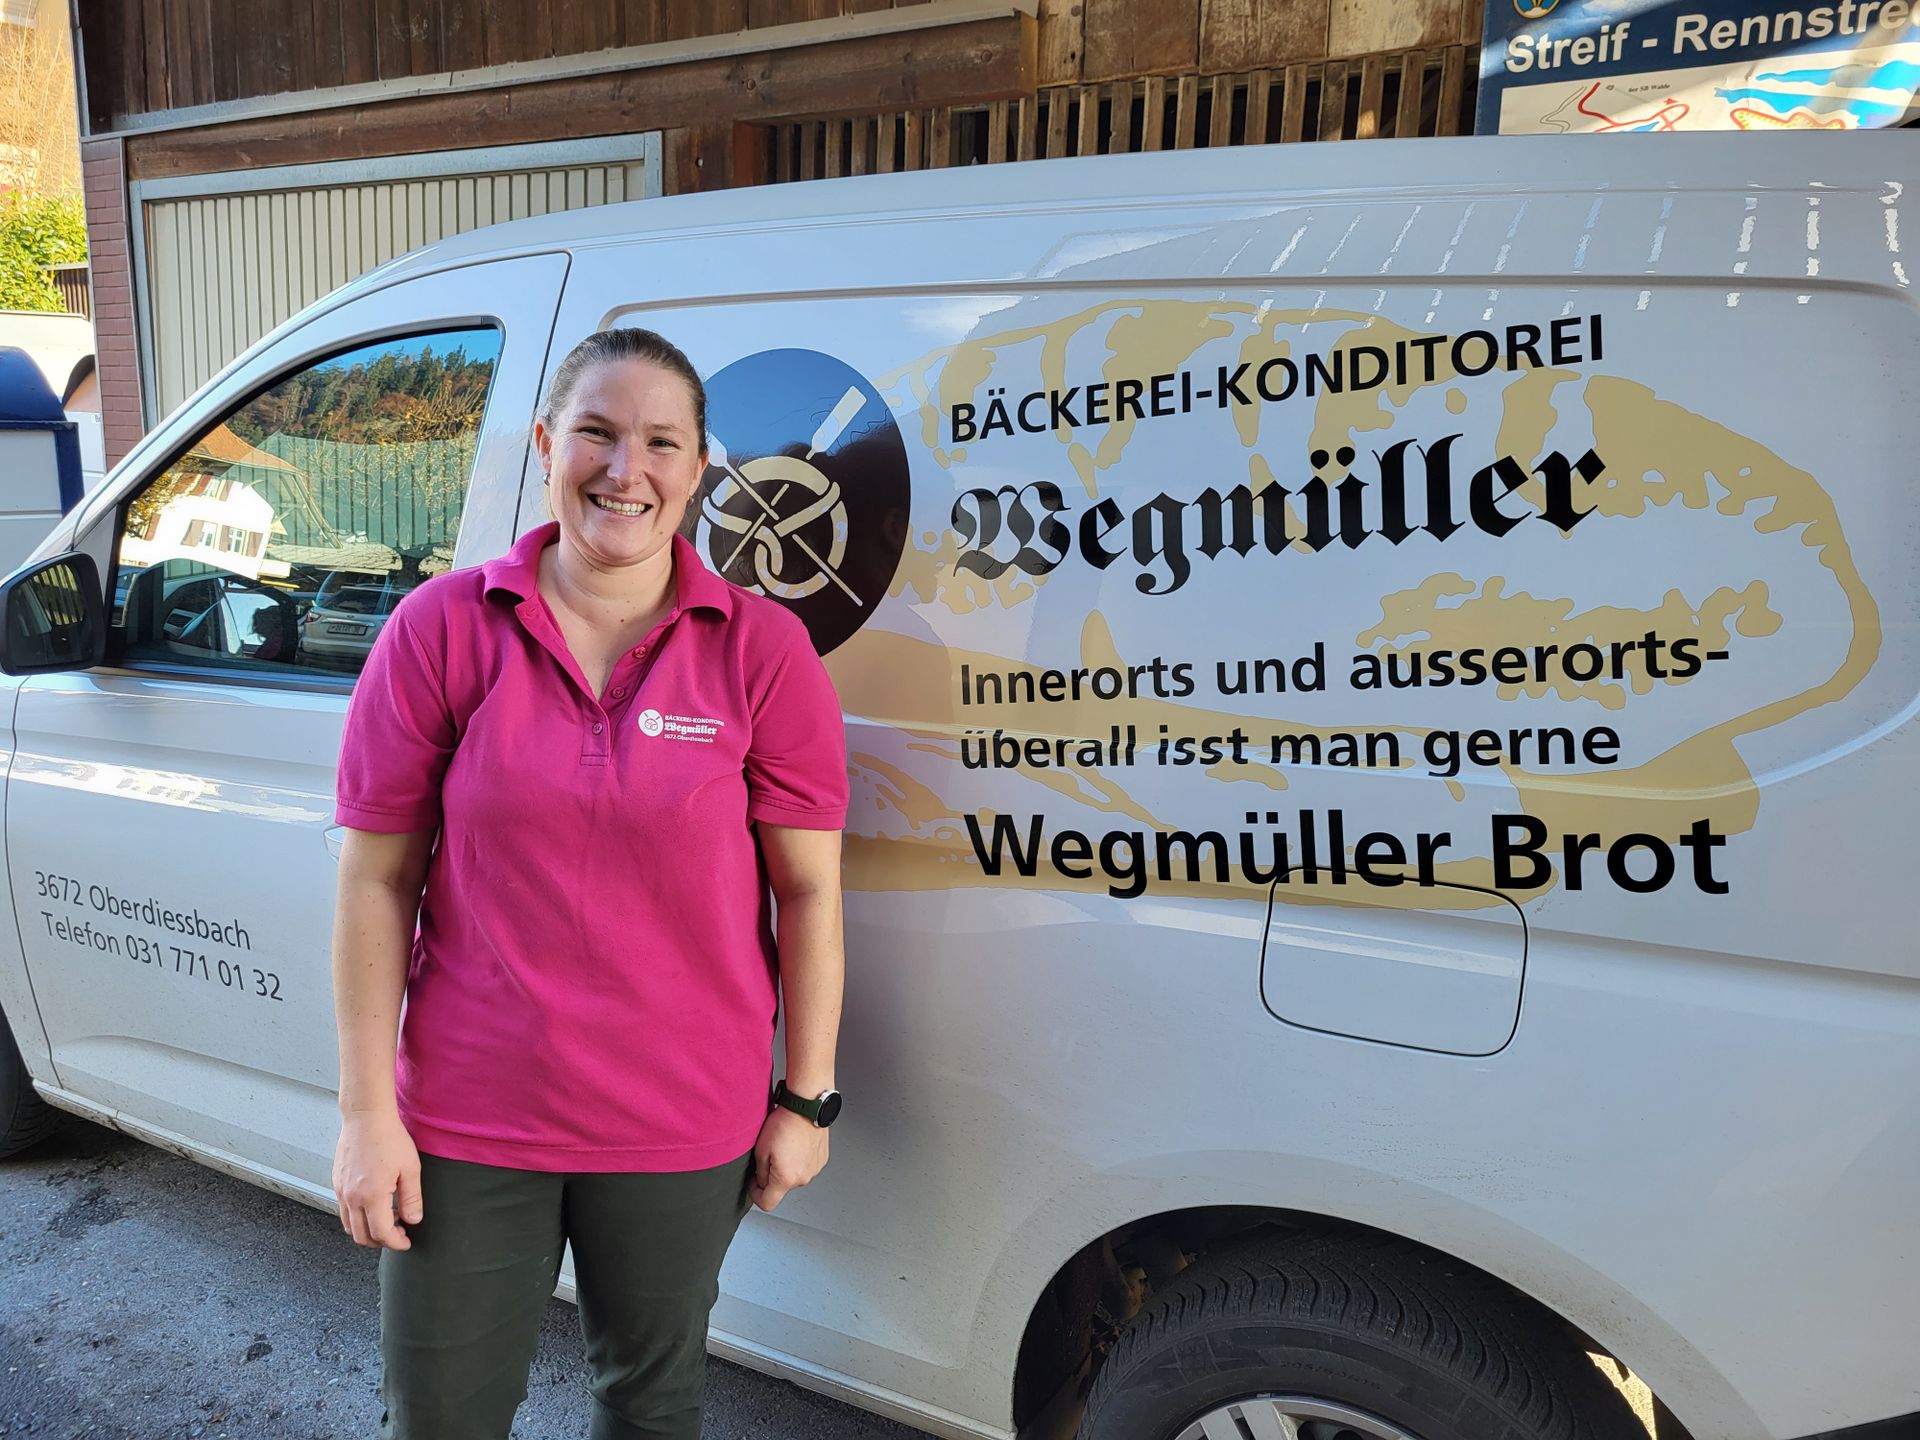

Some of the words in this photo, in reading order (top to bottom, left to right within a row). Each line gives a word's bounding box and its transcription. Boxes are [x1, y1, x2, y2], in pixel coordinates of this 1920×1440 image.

[1505, 22, 1631, 74] Streif
[1673, 0, 1920, 54] Rennstre
[951, 314, 1603, 443] BÄCKEREI-KONDITOREI
[951, 433, 1606, 596] Wegmüller
[961, 656, 1195, 706] Innerorts
[1216, 643, 1326, 694] und
[1350, 631, 1730, 687] ausserorts-
[664, 722, 717, 734] Wegmüller
[961, 726, 1136, 769] überall
[1158, 726, 1249, 767] isst
[1270, 732, 1400, 768] man
[1423, 726, 1621, 778] gerne
[963, 810, 1452, 898] Wegmüller
[1491, 814, 1731, 895] Brot
[35, 871, 84, 906] 3672
[89, 884, 251, 950] Oberdiessbach
[41, 911, 121, 956] Telefon
[125, 934, 163, 968] 031
[170, 946, 209, 981] 771
[217, 959, 244, 991] 01
[252, 968, 284, 1001] 32
